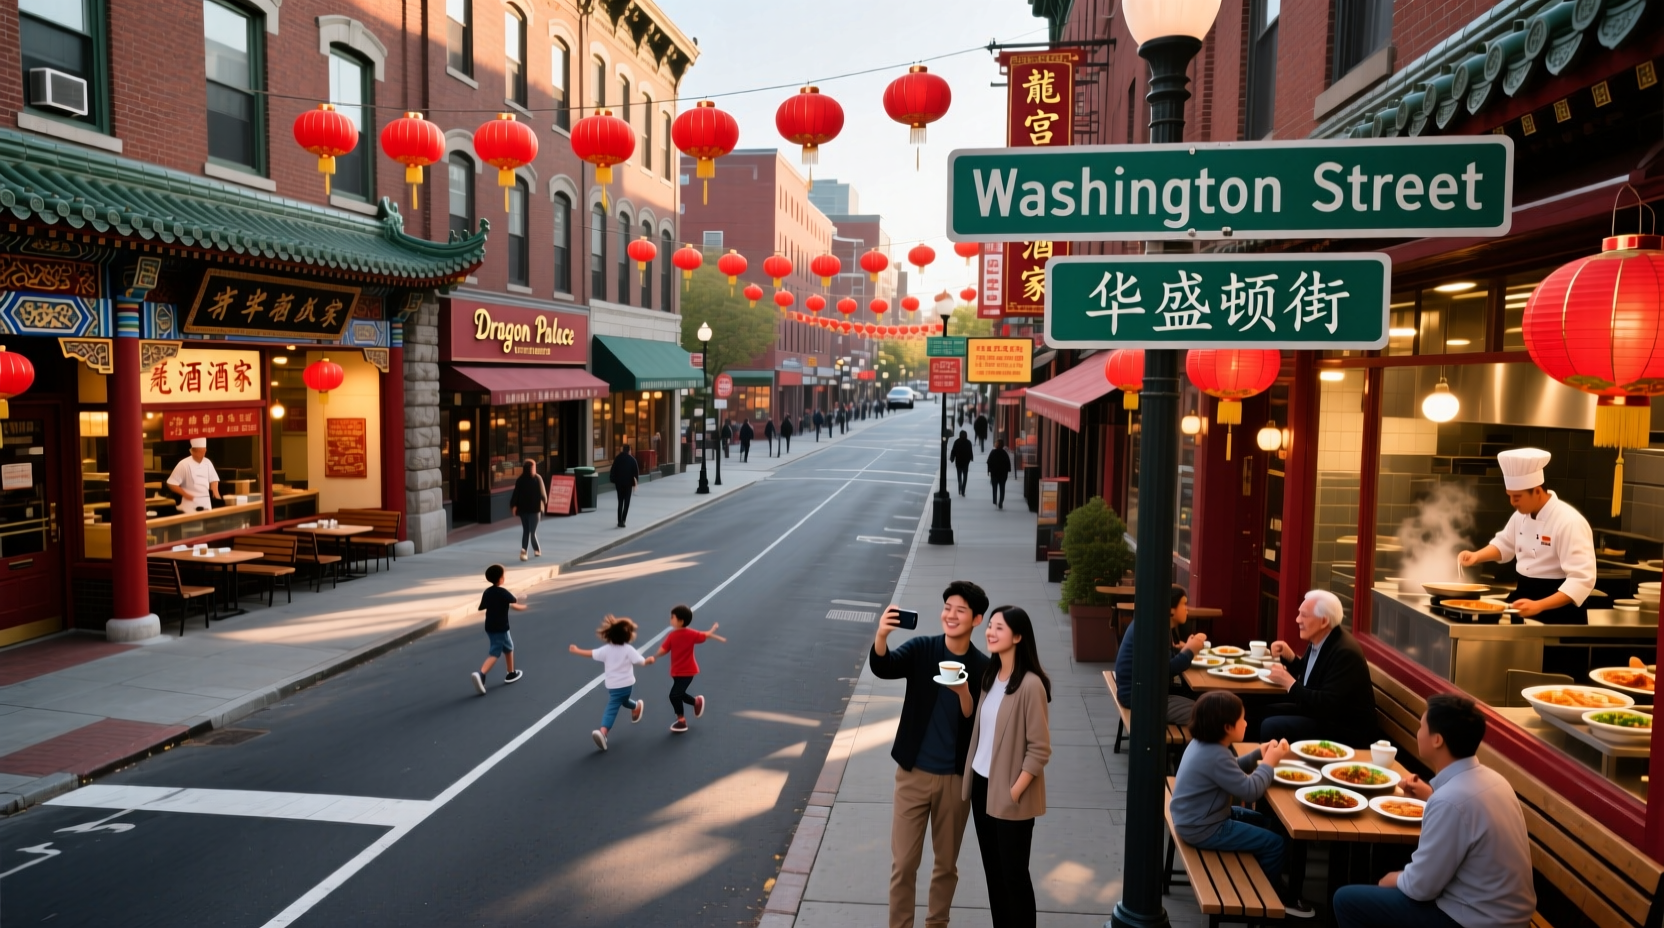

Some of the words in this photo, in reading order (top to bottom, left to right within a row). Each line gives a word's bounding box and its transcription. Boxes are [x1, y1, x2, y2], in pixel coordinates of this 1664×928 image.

[973, 166, 1282, 229] Washington
[1312, 161, 1483, 213] Street
[474, 307, 531, 354] Dragon
[534, 314, 575, 346] Palace
[1085, 269, 1350, 336] 华盛顿街
